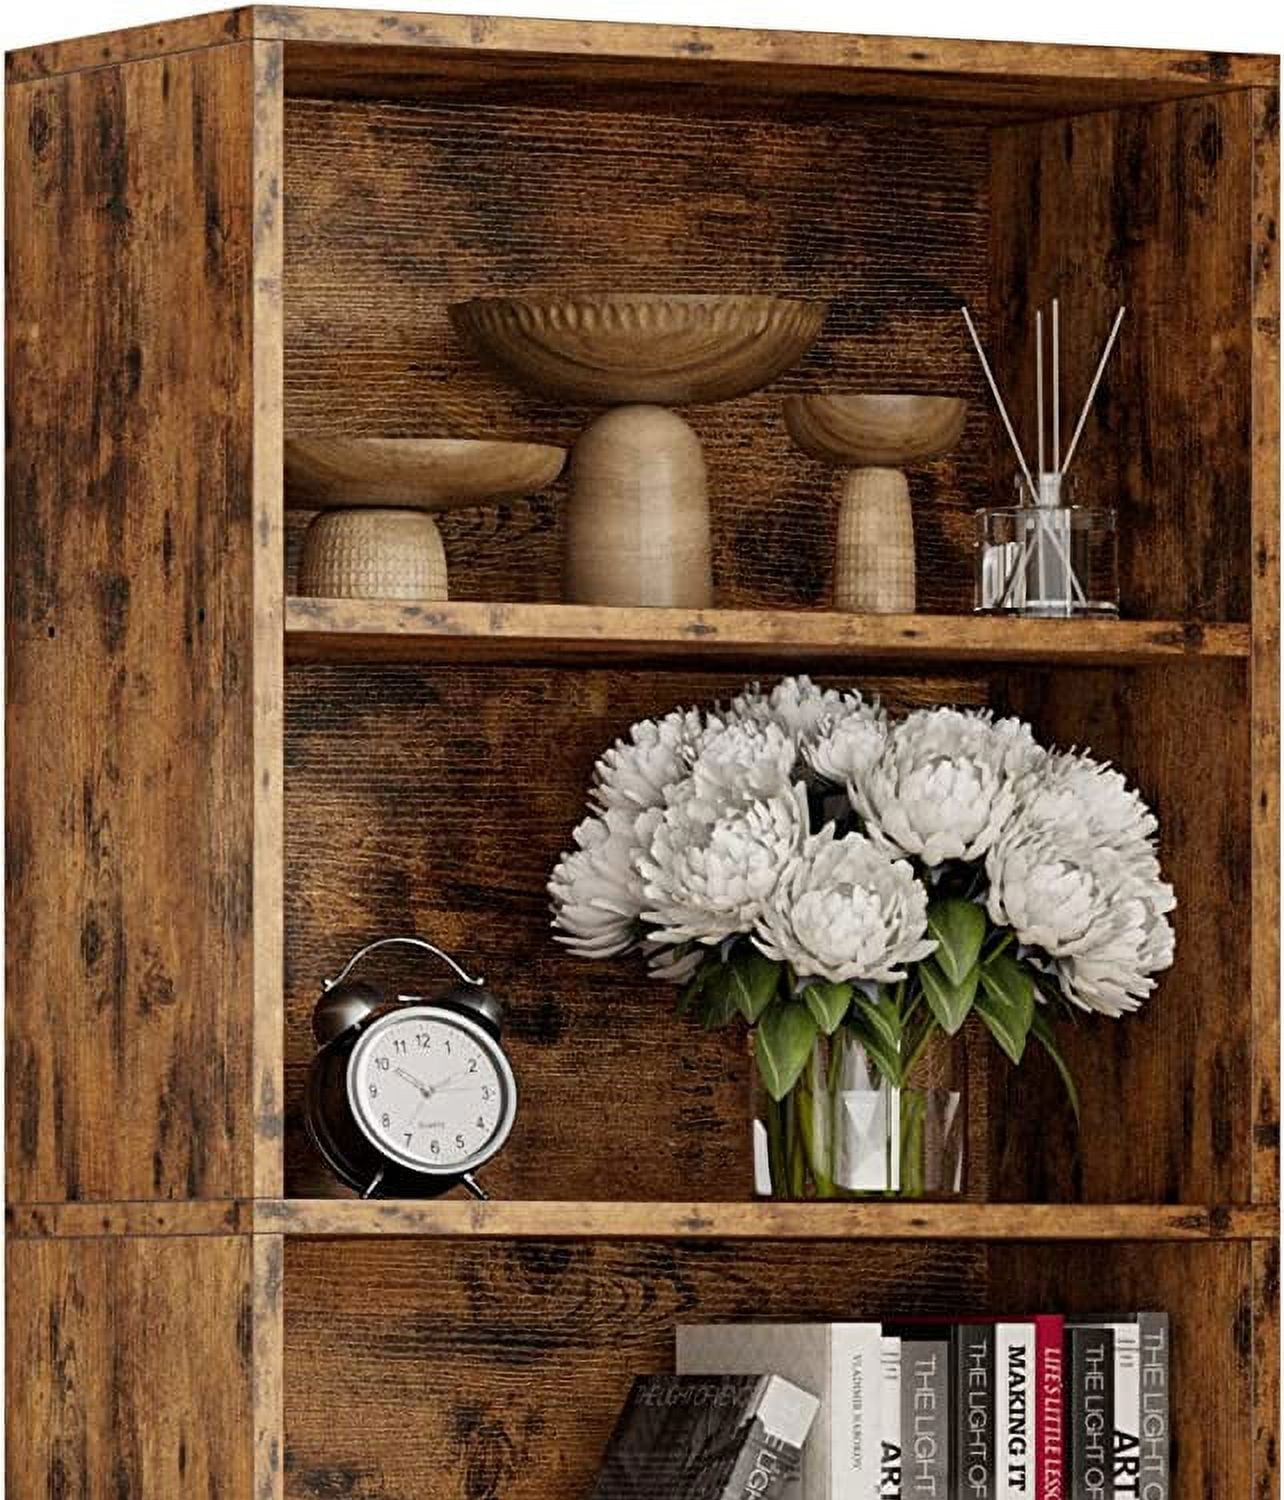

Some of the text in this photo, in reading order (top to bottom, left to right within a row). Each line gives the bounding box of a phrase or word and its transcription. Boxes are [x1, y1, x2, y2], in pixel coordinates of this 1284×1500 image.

[393, 1040, 406, 1053] 11
[416, 1033, 430, 1049] 12
[445, 1040, 451, 1053] 1
[374, 1058, 390, 1071] 10
[467, 1059, 478, 1073] 2
[369, 1084, 378, 1099] 9
[481, 1085, 489, 1101] 3
[381, 1113, 390, 1129] 8
[476, 1116, 485, 1129] 4
[403, 1133, 413, 1148] 7
[430, 1139, 440, 1154] 6
[455, 1135, 465, 1149] 5
[969, 1339, 987, 1388] THE
[1045, 1347, 1063, 1394] LIFE'S
[1085, 1343, 1104, 1391] THE
[1143, 1328, 1165, 1387] THE
[914, 1354, 936, 1410] THE
[969, 1391, 987, 1462] LIGHT
[1008, 1344, 1026, 1492] MAKING IT
[1045, 1396, 1061, 1457] LITTLE
[1085, 1396, 1104, 1463] LIGHT
[1143, 1393, 1165, 1478] LIGHT
[914, 1416, 936, 1497] LIGHT
[1112, 1429, 1139, 1499] ART
[969, 1464, 987, 1499] OF
[1085, 1467, 1104, 1500] OF
